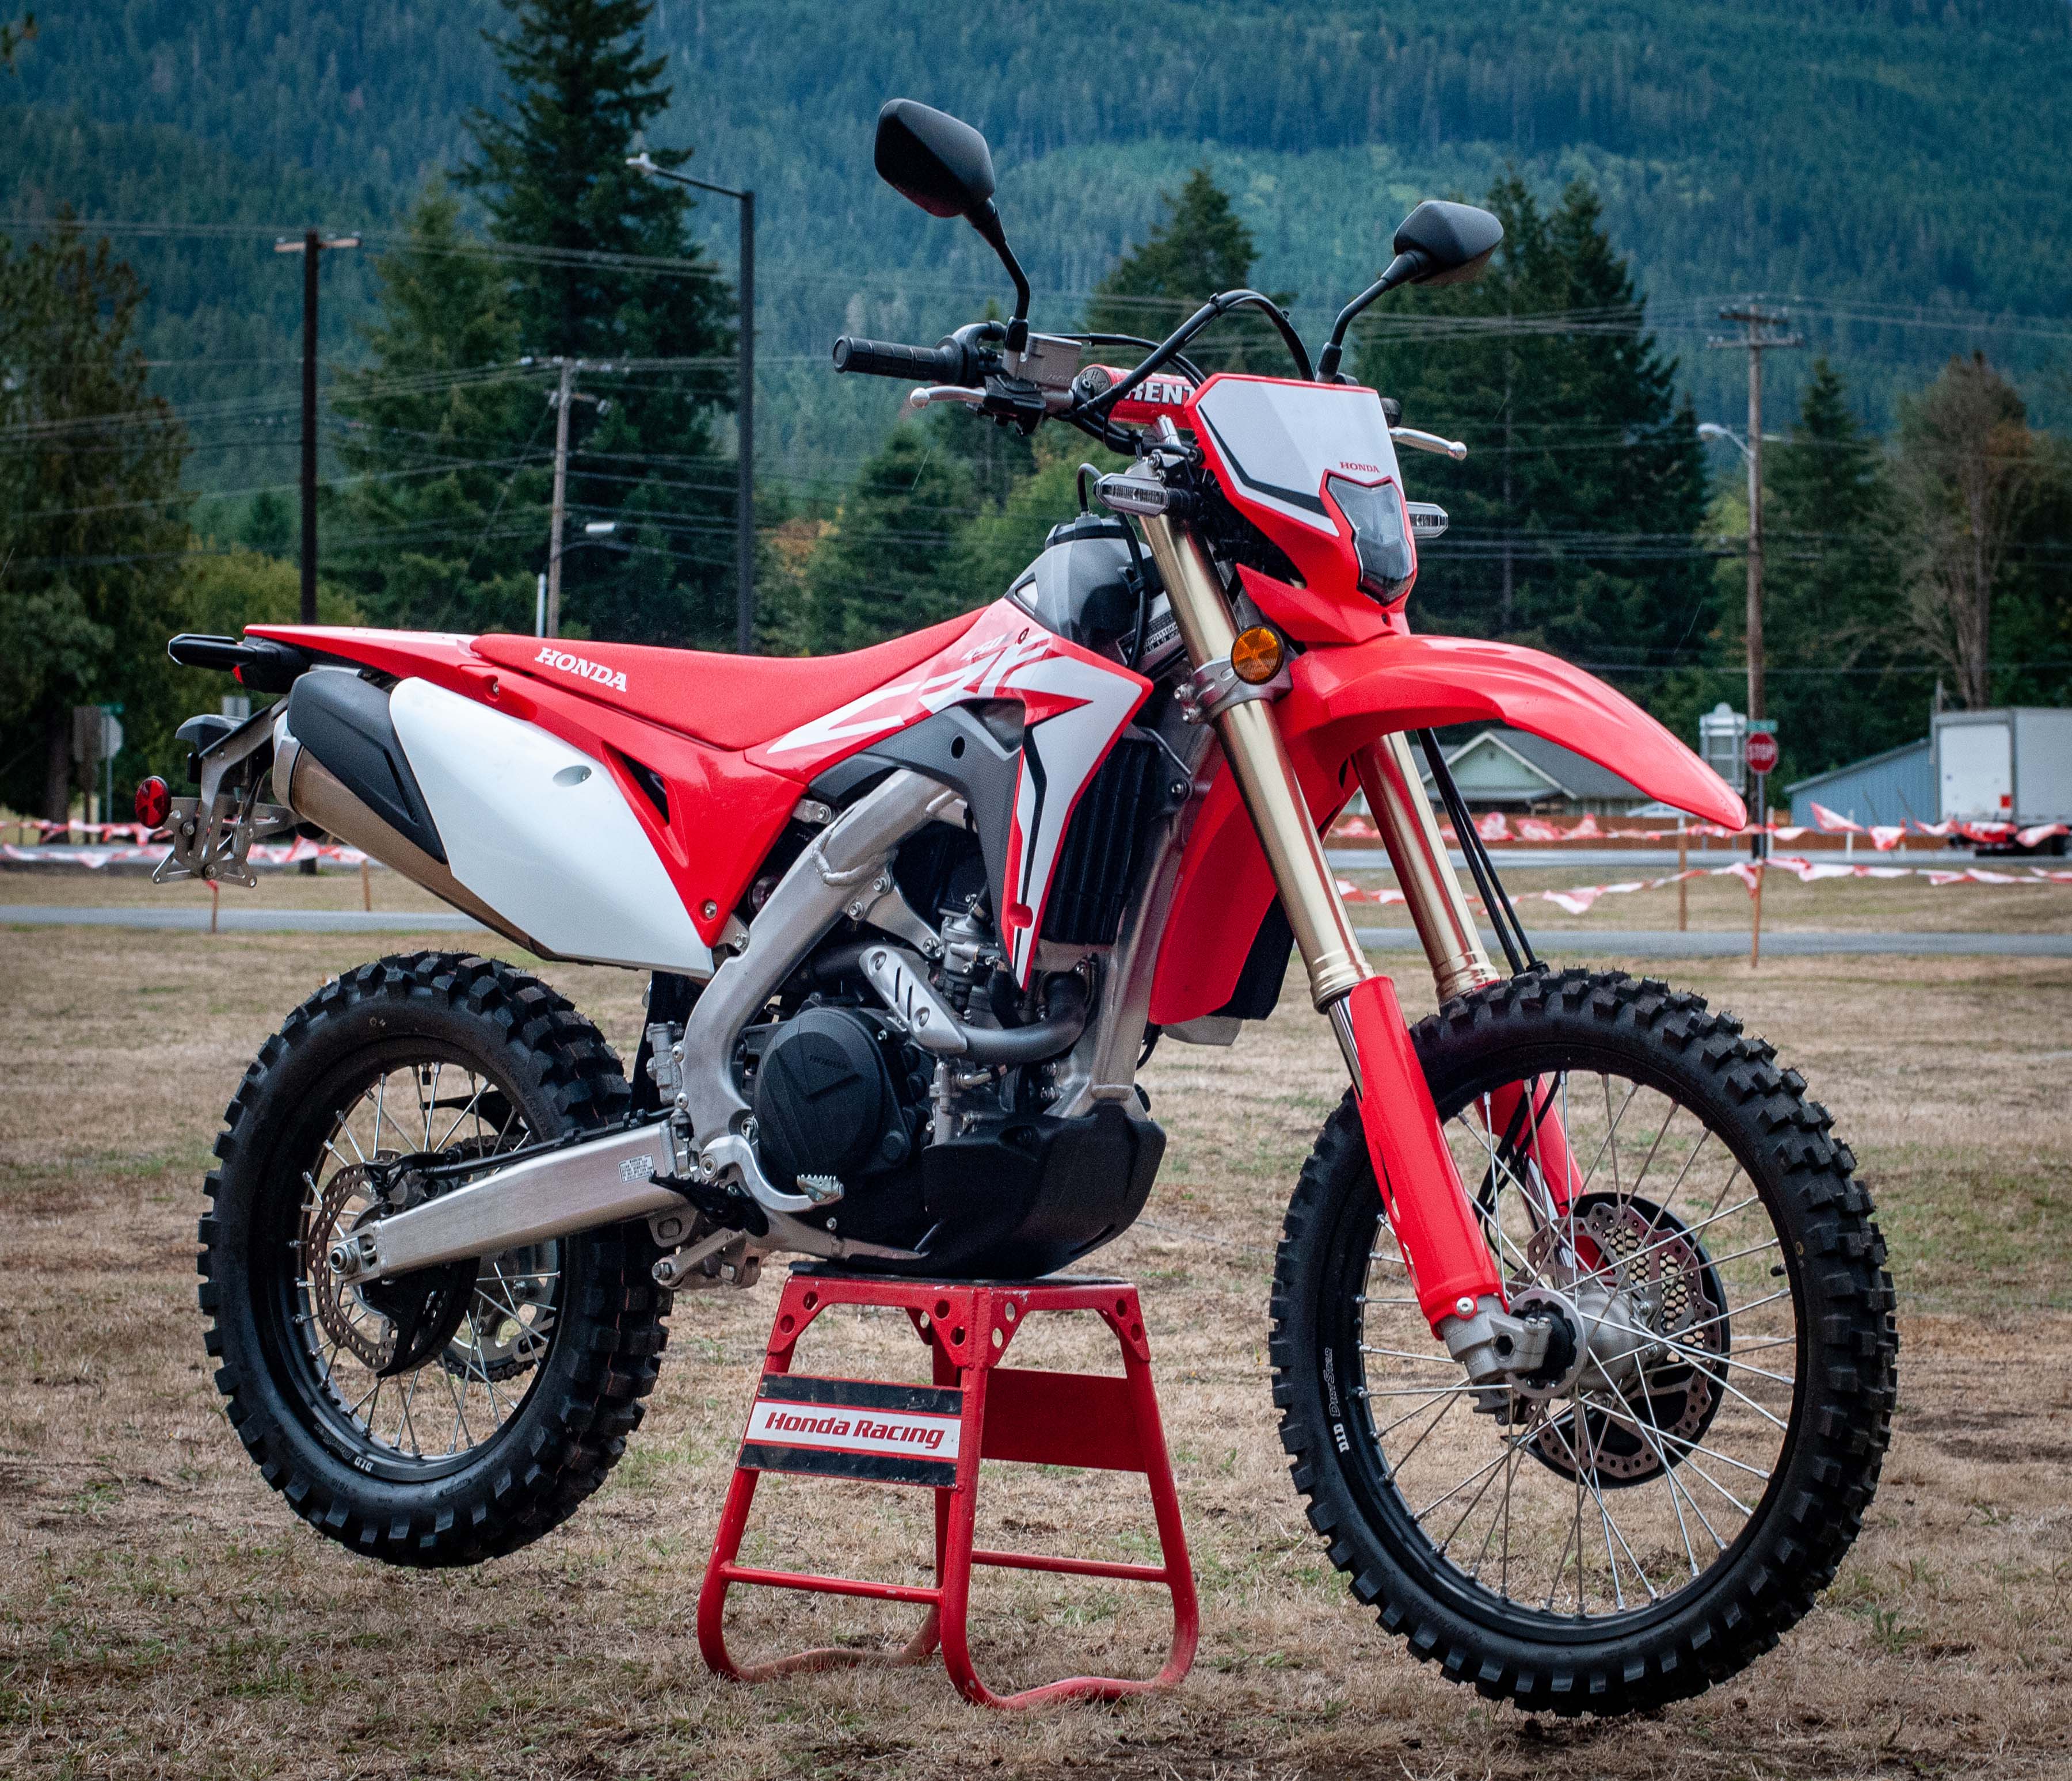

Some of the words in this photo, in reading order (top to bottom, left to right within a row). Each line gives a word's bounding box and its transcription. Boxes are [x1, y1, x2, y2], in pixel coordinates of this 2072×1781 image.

[1339, 461, 1380, 474] HONDA
[534, 647, 627, 692] HONDA
[1746, 743, 1776, 760] STOP
[764, 1412, 851, 1436] Honda
[853, 1419, 945, 1450] Racing
[1333, 1422, 1350, 1453] DID
[354, 1456, 374, 1472] DID
